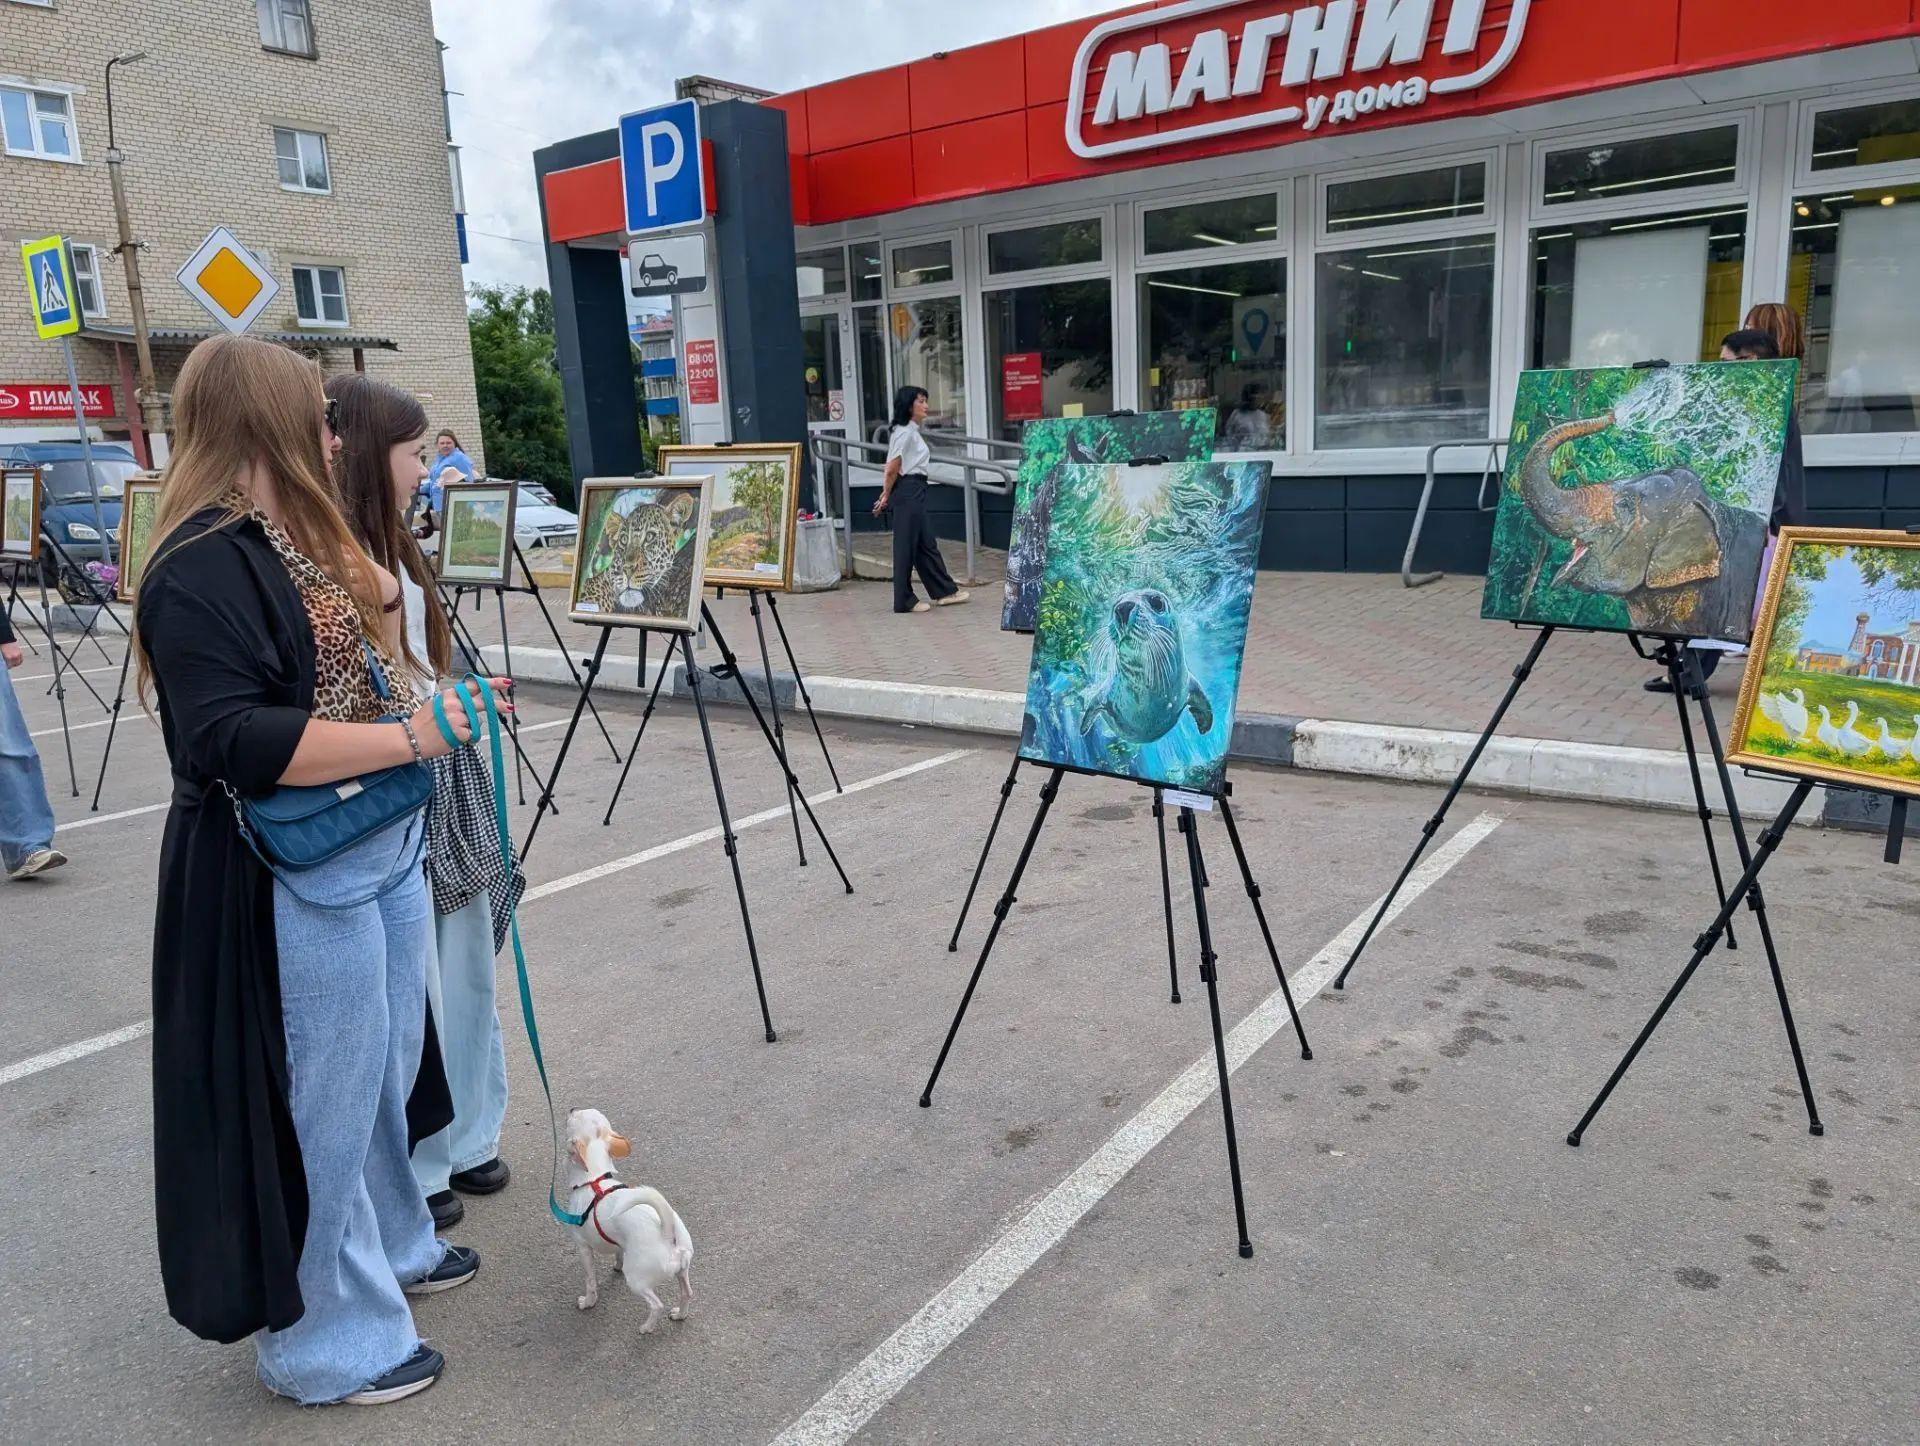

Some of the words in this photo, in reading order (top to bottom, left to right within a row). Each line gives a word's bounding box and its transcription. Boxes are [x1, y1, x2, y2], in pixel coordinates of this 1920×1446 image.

[1303, 95, 1330, 131] у
[1329, 76, 1427, 123] дома
[641, 120, 684, 217] P
[29, 390, 101, 405] ЛИМАК
